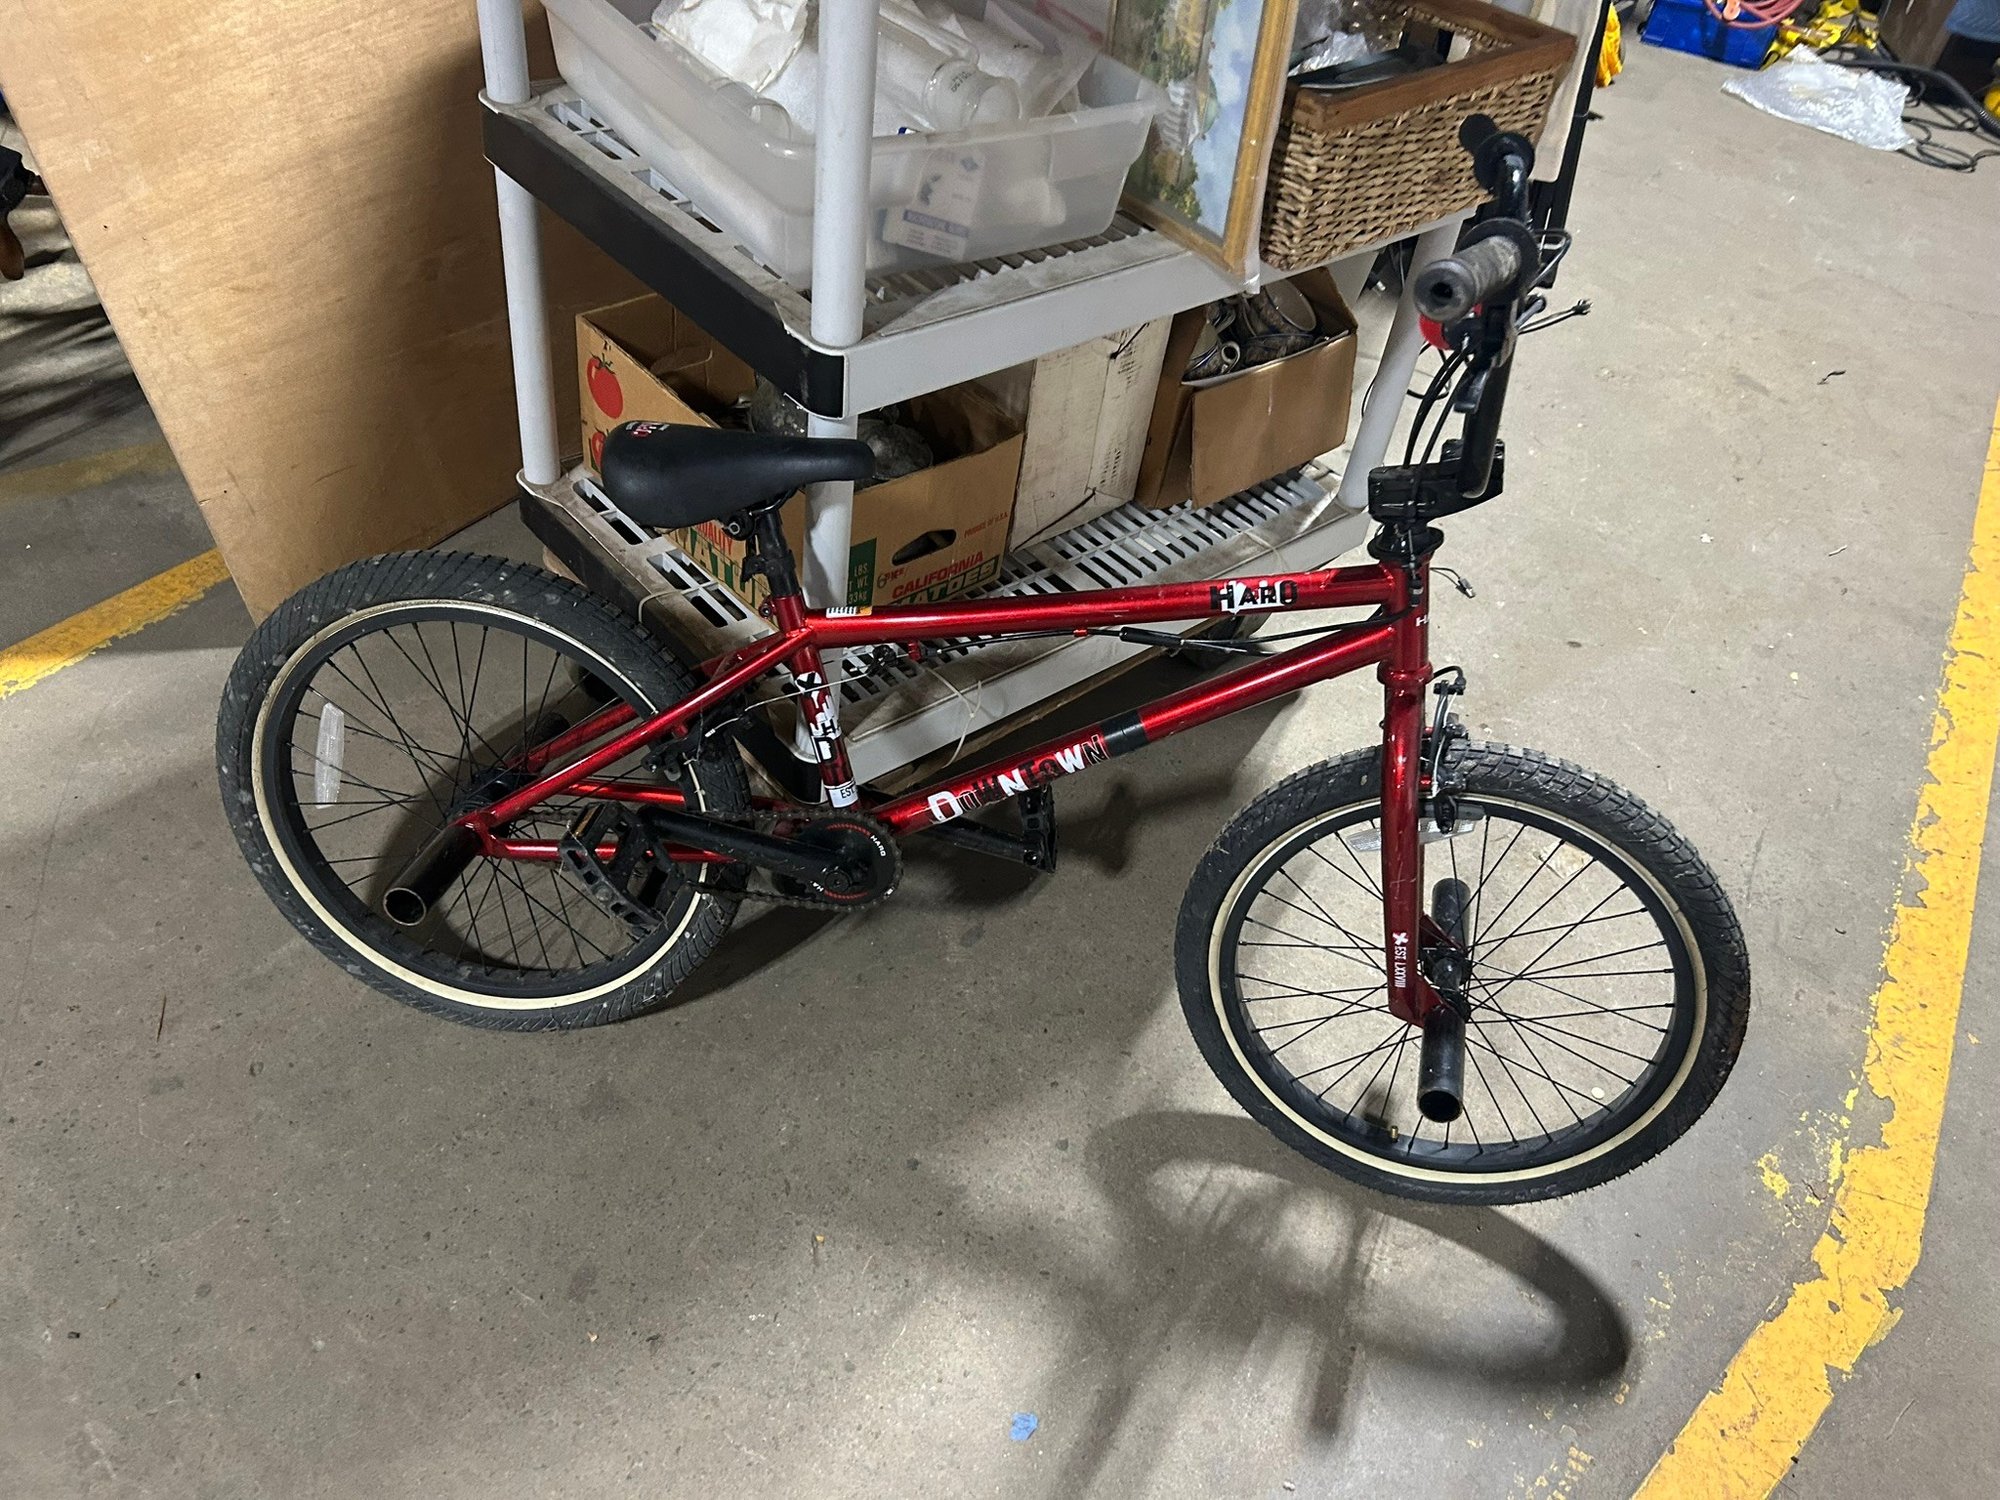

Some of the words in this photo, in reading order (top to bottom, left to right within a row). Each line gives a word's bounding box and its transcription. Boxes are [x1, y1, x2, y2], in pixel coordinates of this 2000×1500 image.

[892, 551, 983, 599] CALIFORNIA
[1210, 580, 1298, 611] HARO
[871, 835, 886, 857] HARO
